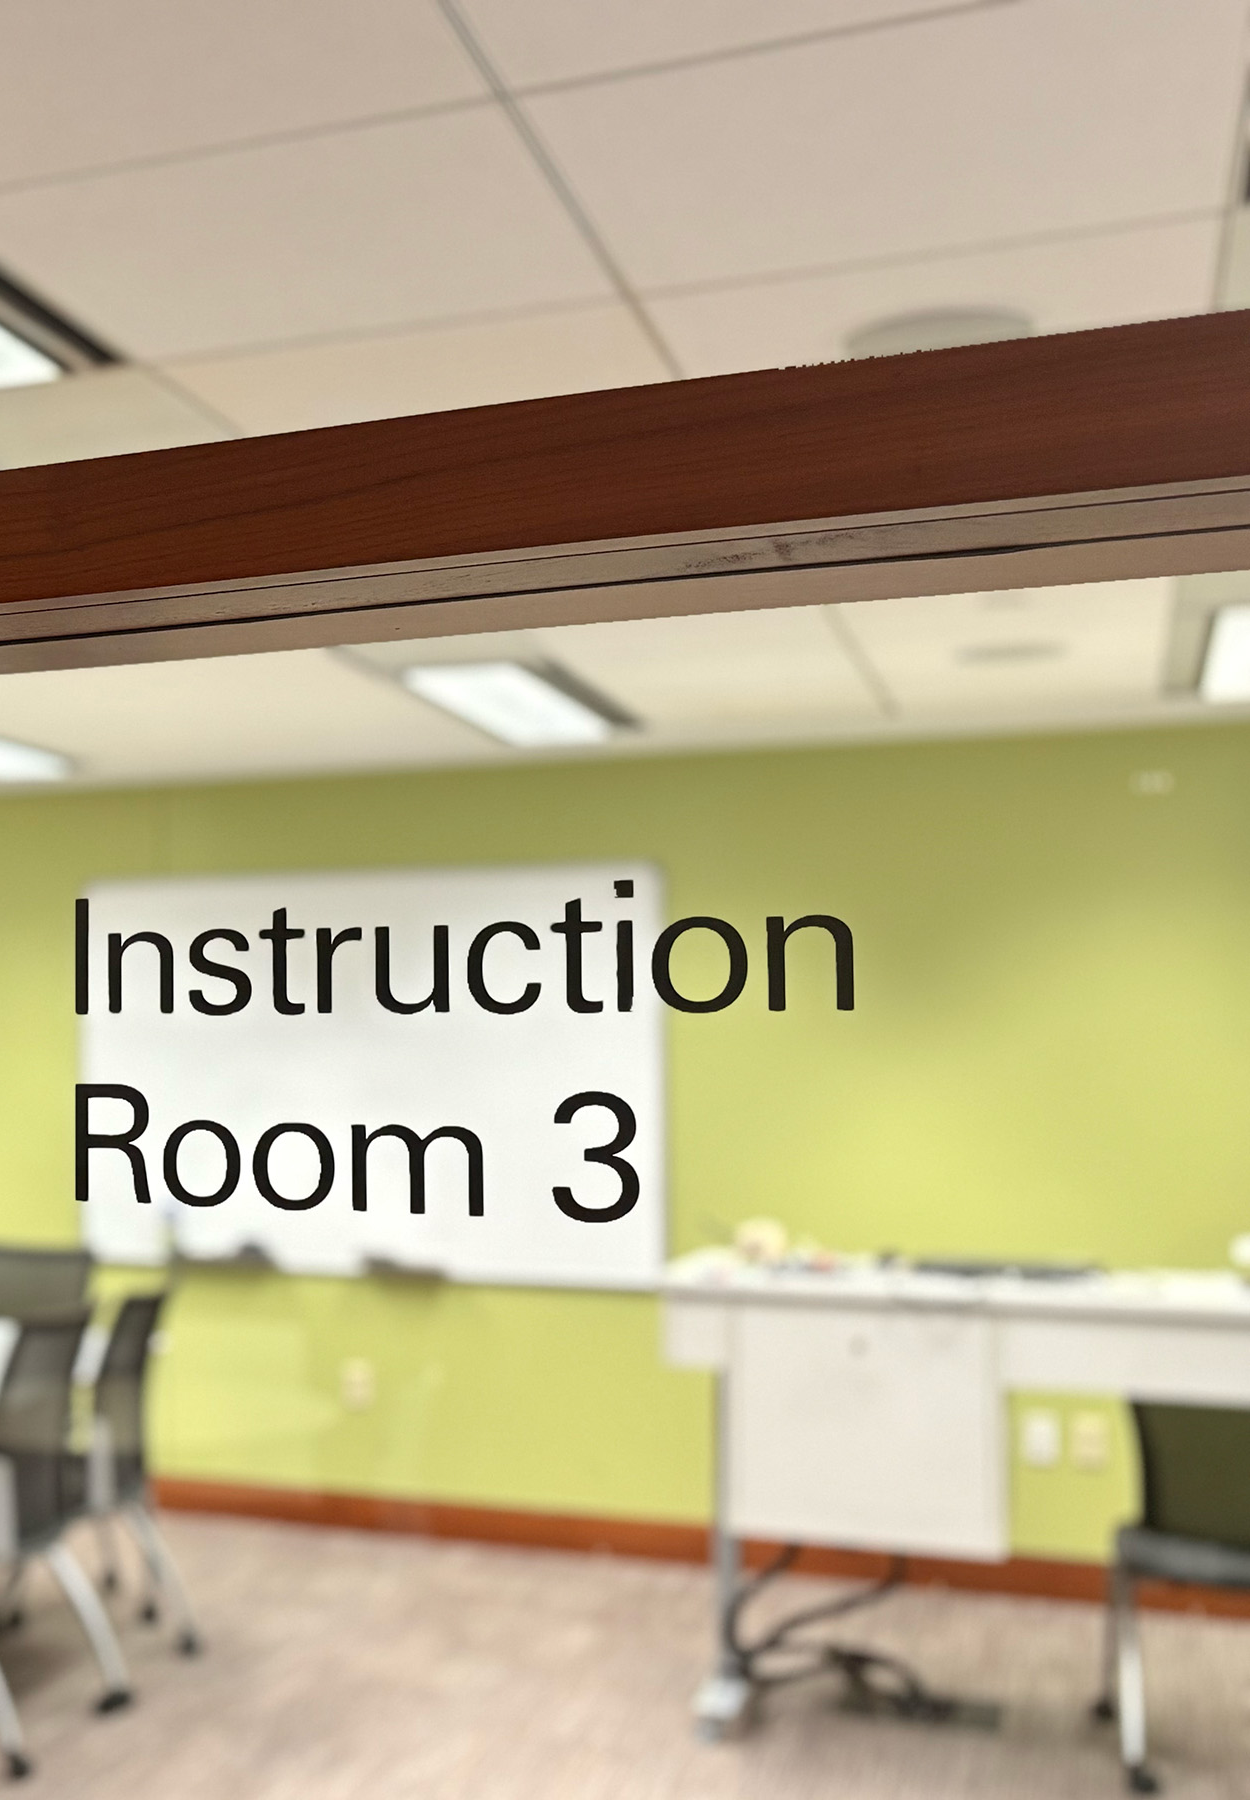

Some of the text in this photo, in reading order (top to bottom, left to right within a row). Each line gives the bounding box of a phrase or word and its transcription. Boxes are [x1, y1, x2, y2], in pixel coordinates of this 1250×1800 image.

[76, 881, 854, 1015] Instruction
[76, 1084, 639, 1222] Room 3
